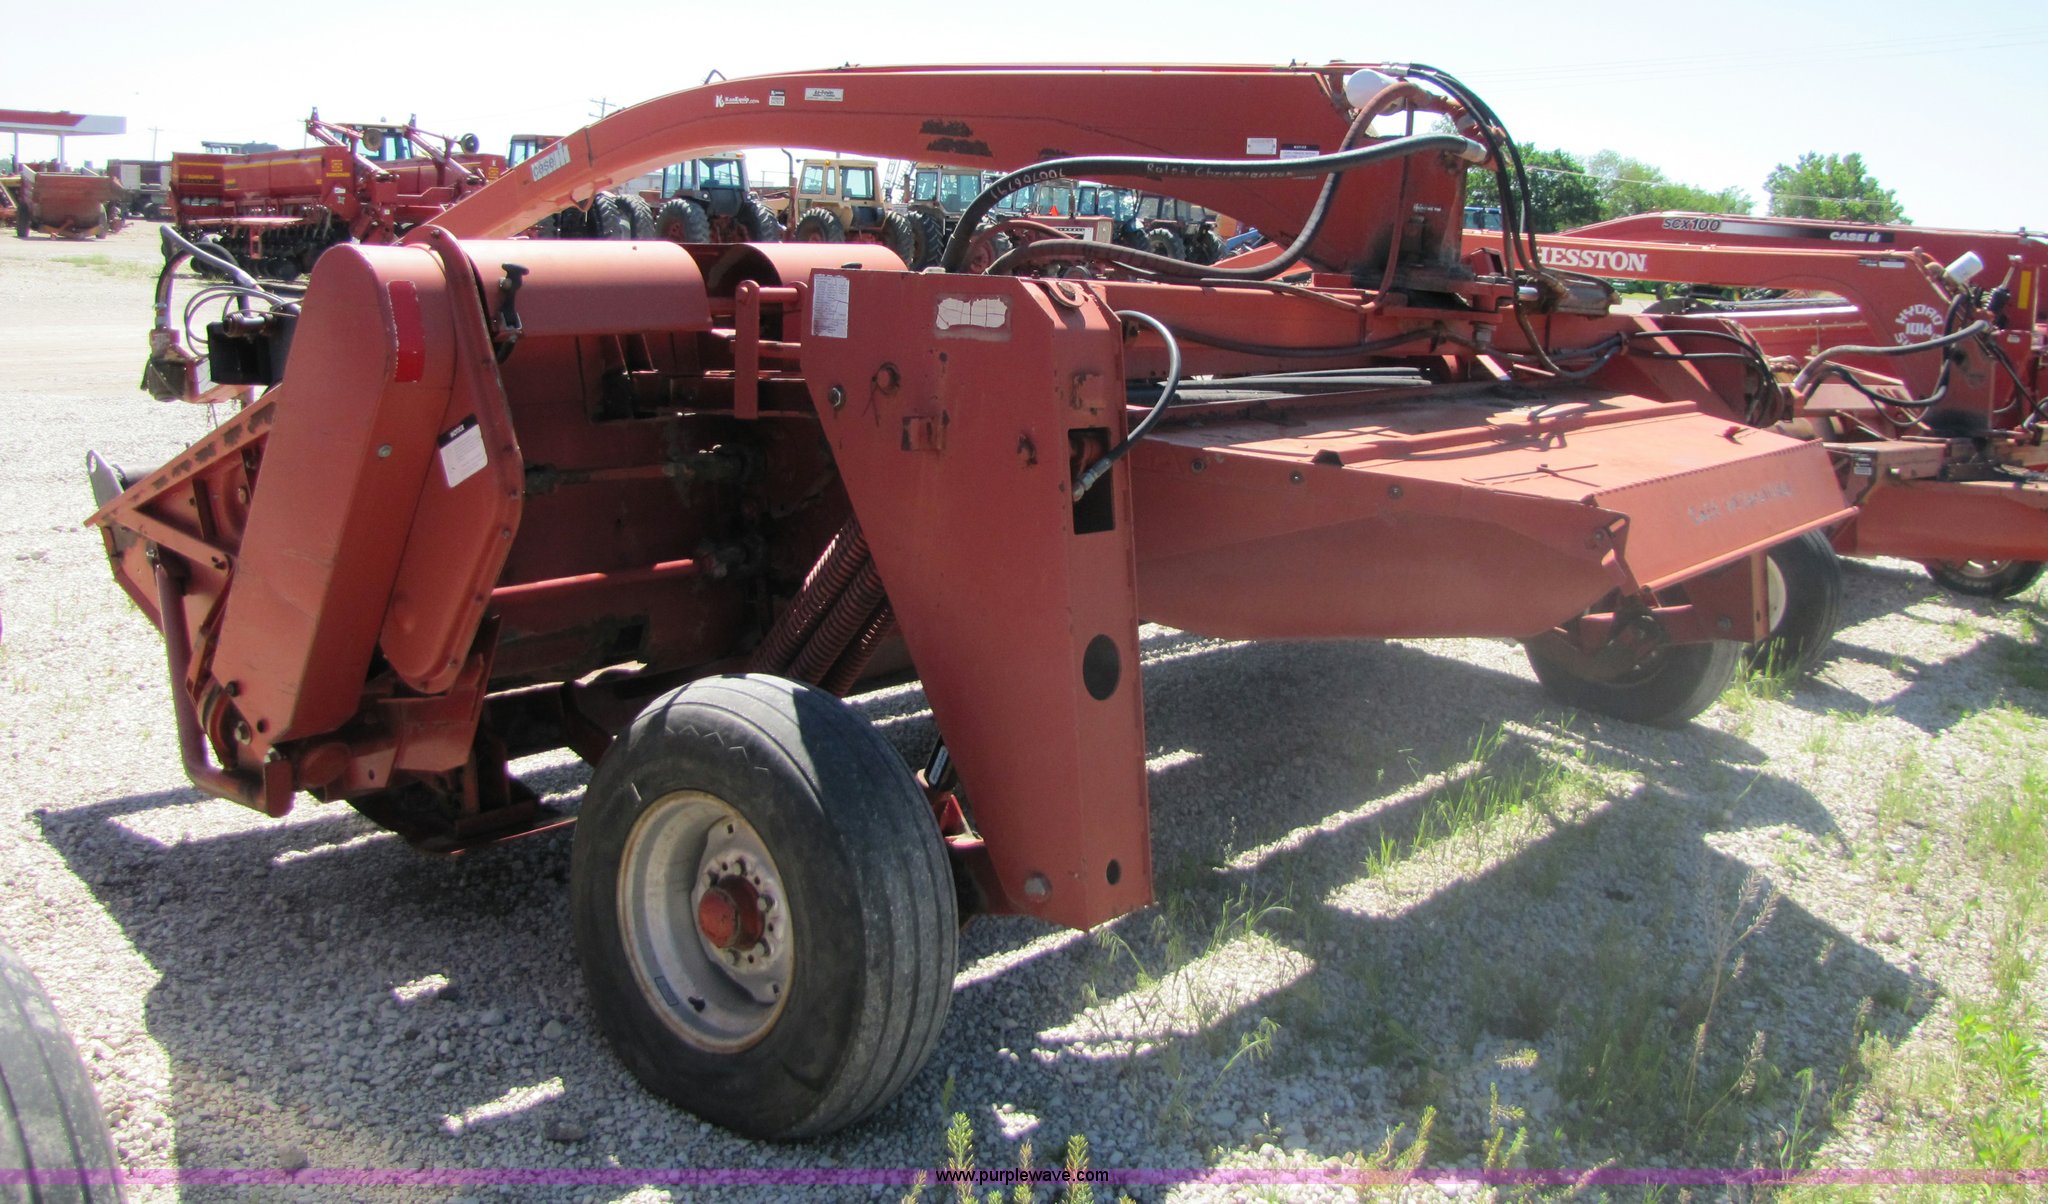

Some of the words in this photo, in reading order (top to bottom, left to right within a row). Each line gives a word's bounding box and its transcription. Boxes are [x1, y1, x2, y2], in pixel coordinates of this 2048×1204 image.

[1663, 218, 1721, 232] SCX100
[1829, 231, 1868, 242] CASE
[1895, 303, 1944, 325] HYDRO
[1905, 321, 1933, 336] 1014
